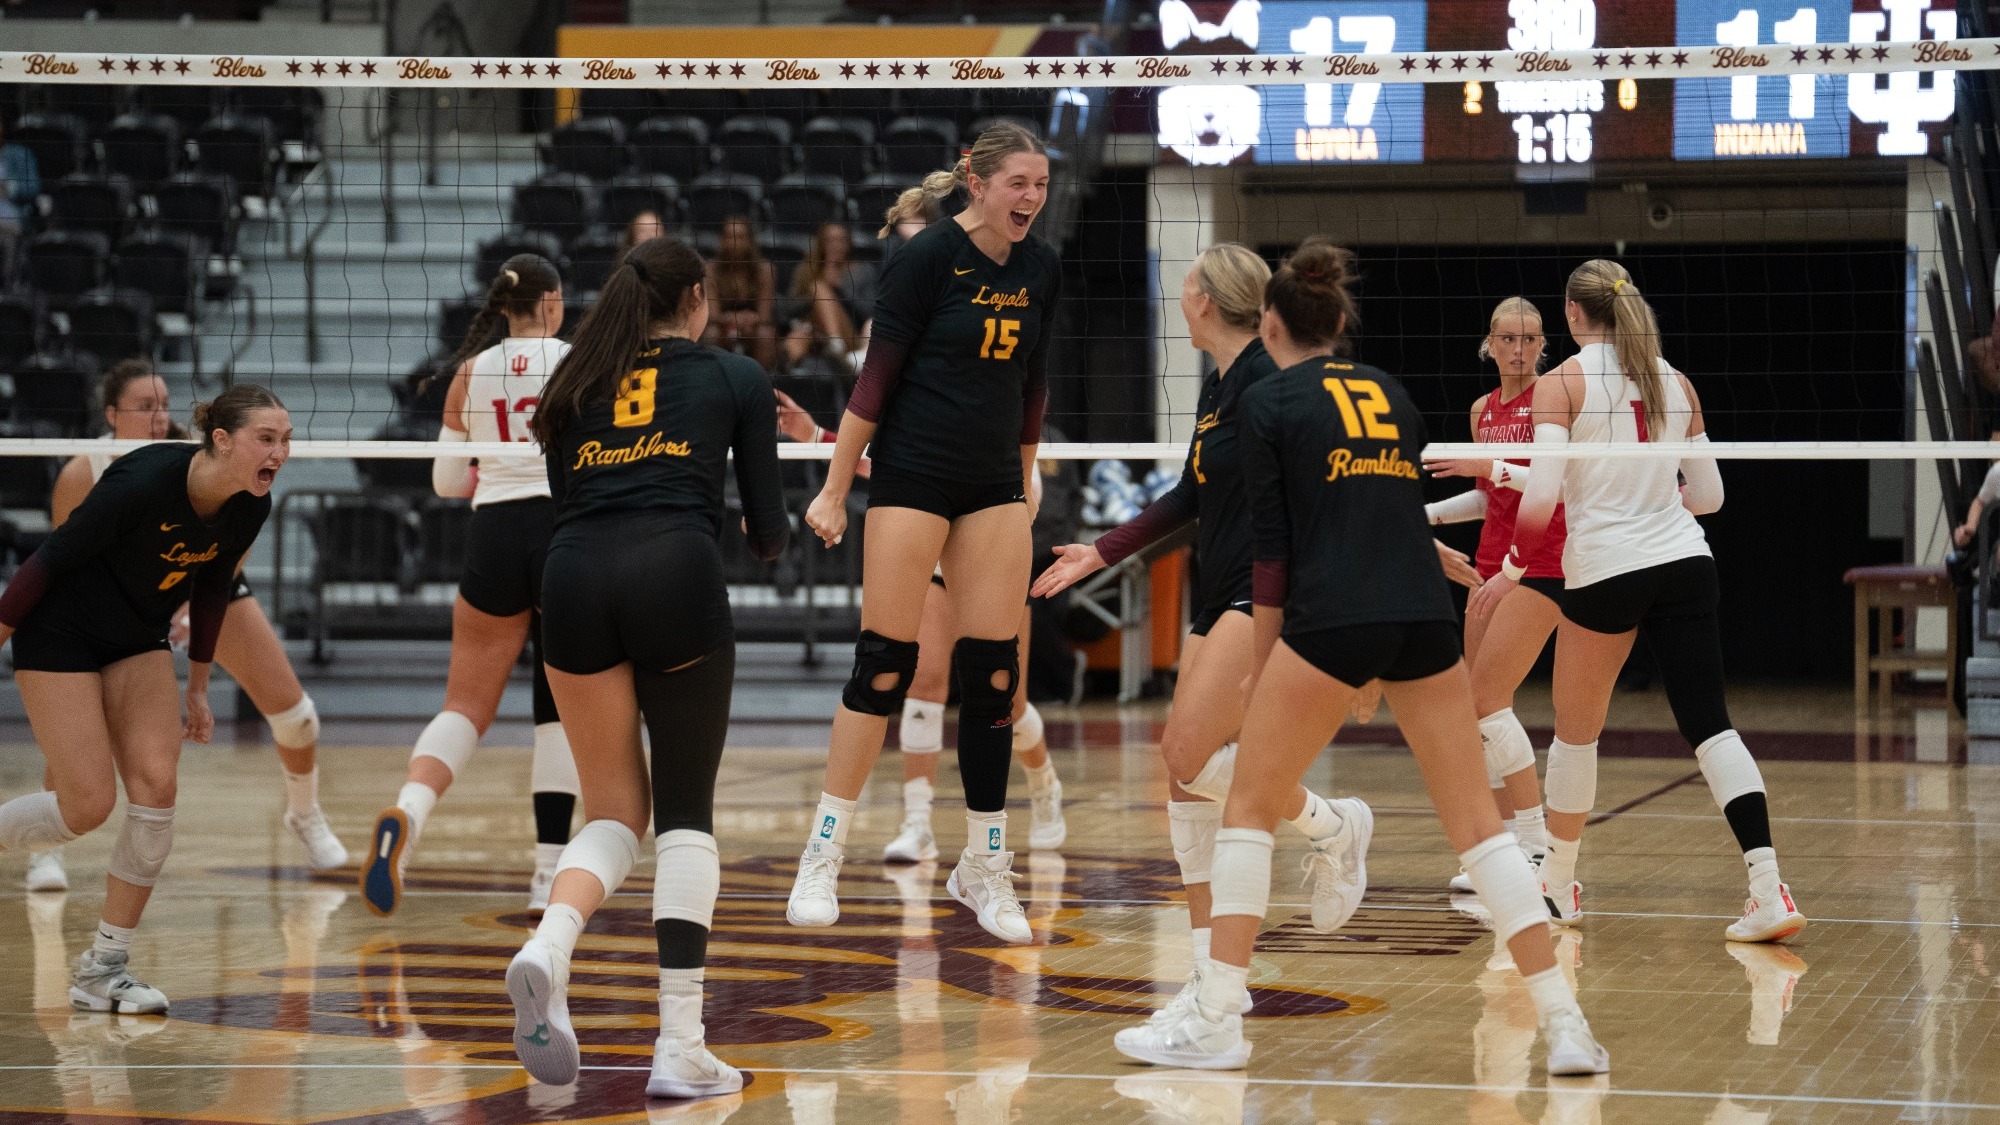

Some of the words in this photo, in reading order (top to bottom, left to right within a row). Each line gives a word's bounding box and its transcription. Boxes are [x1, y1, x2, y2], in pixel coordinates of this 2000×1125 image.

[1290, 16, 1395, 126] 17
[1716, 8, 1816, 120] 11
[1512, 113, 1592, 163] 1:15
[1714, 122, 1807, 155] INDIANA
[971, 285, 1029, 312] Loyola
[979, 318, 1021, 360] 15
[613, 367, 658, 428] 8
[1322, 377, 1400, 441] 12
[573, 431, 691, 471] Ramblers
[1326, 448, 1419, 482] Ramblers
